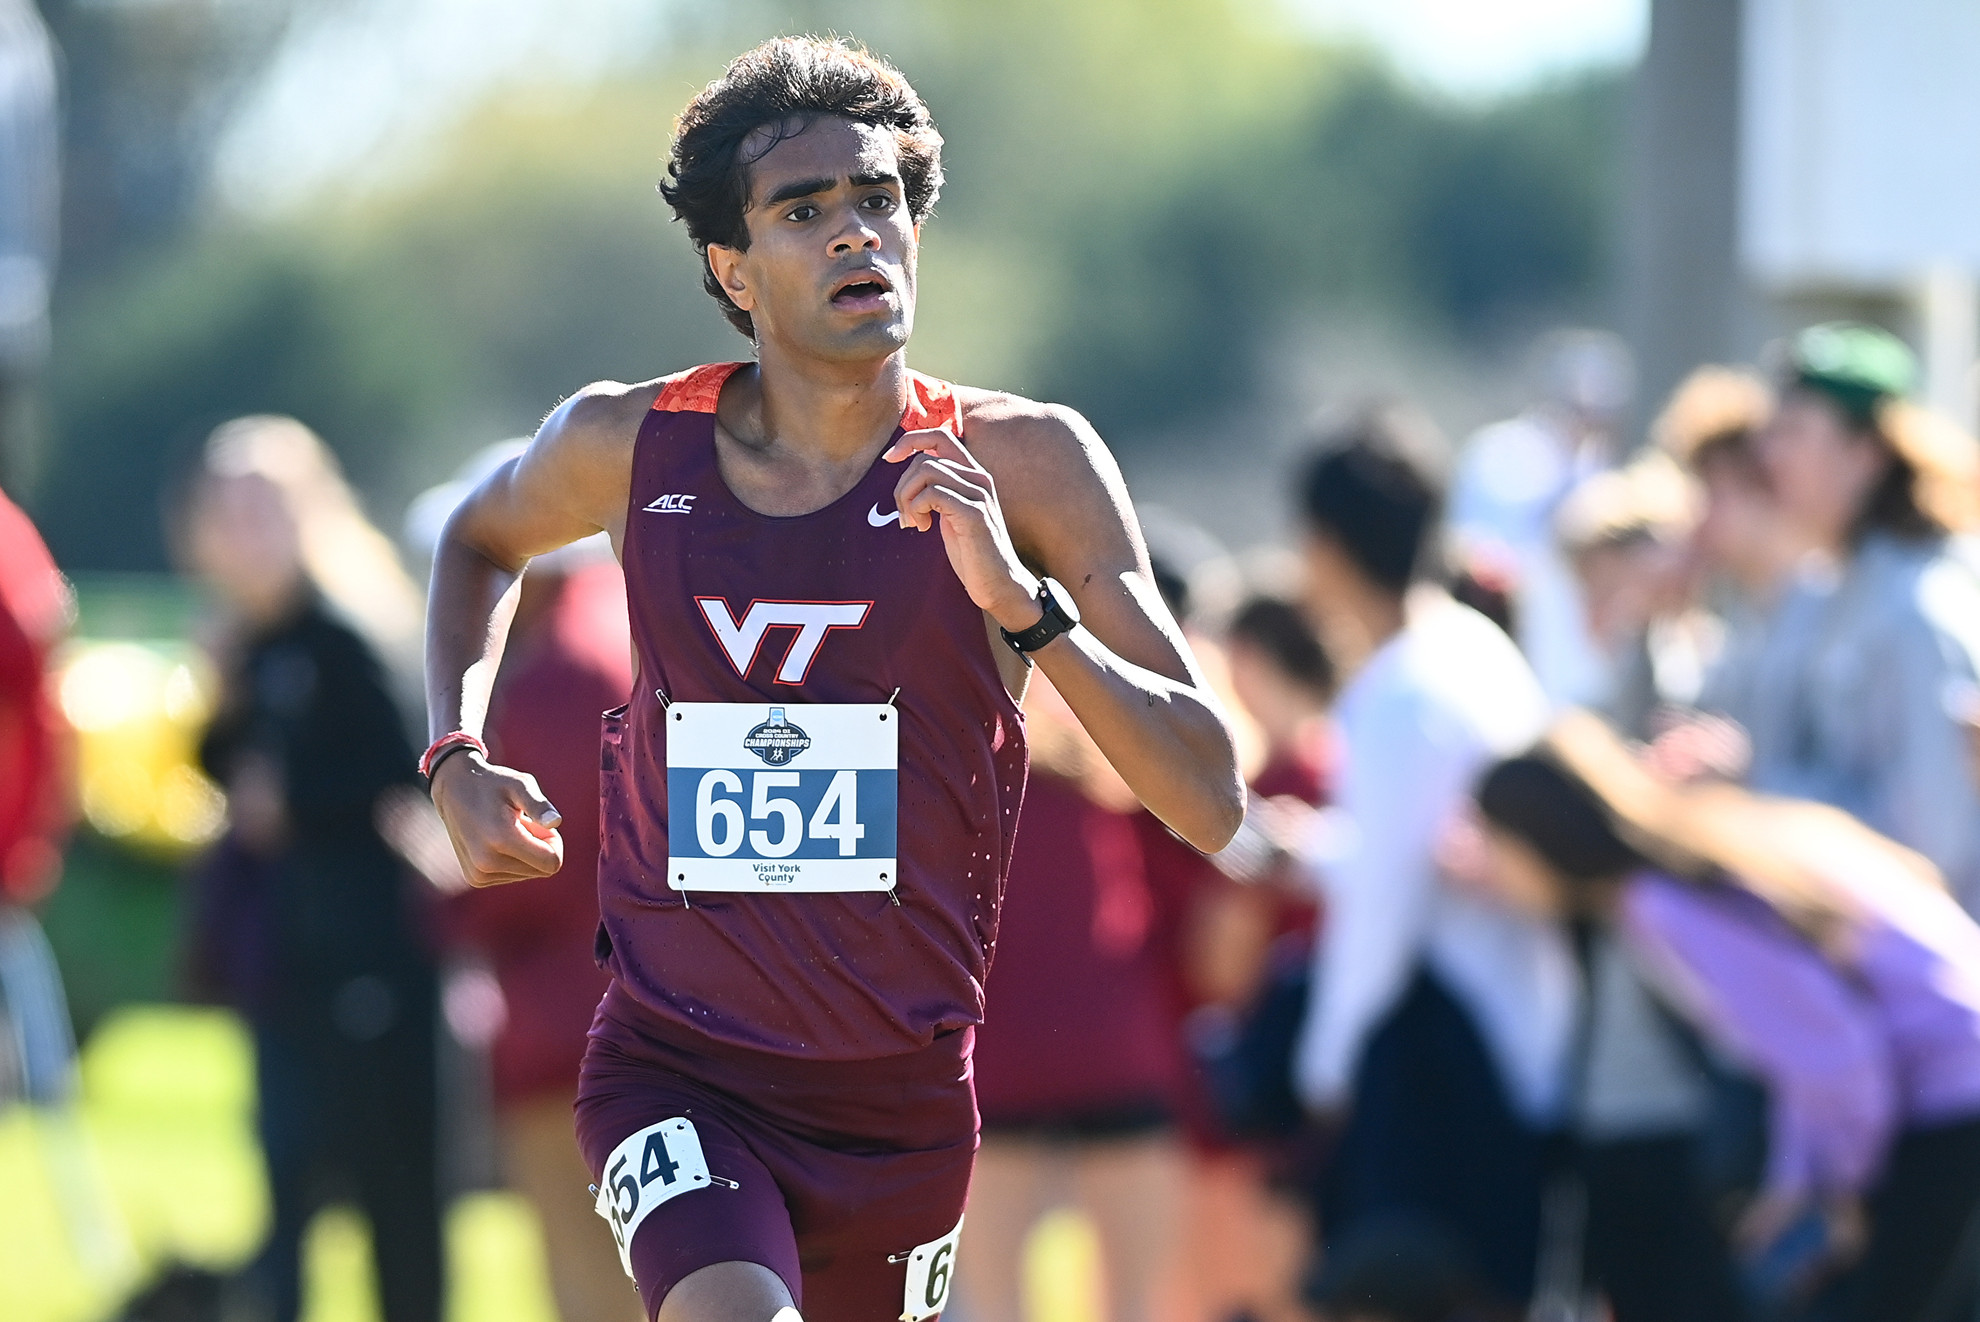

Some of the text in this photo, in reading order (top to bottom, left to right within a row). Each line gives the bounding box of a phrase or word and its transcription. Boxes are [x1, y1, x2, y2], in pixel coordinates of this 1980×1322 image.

[643, 494, 697, 513] ACC
[694, 596, 874, 686] VT
[744, 738, 810, 748] CHAMPIONSHIPS
[695, 769, 865, 858] 654
[752, 862, 801, 873] Visit York
[758, 873, 795, 883] County
[925, 1241, 952, 1309] 6
